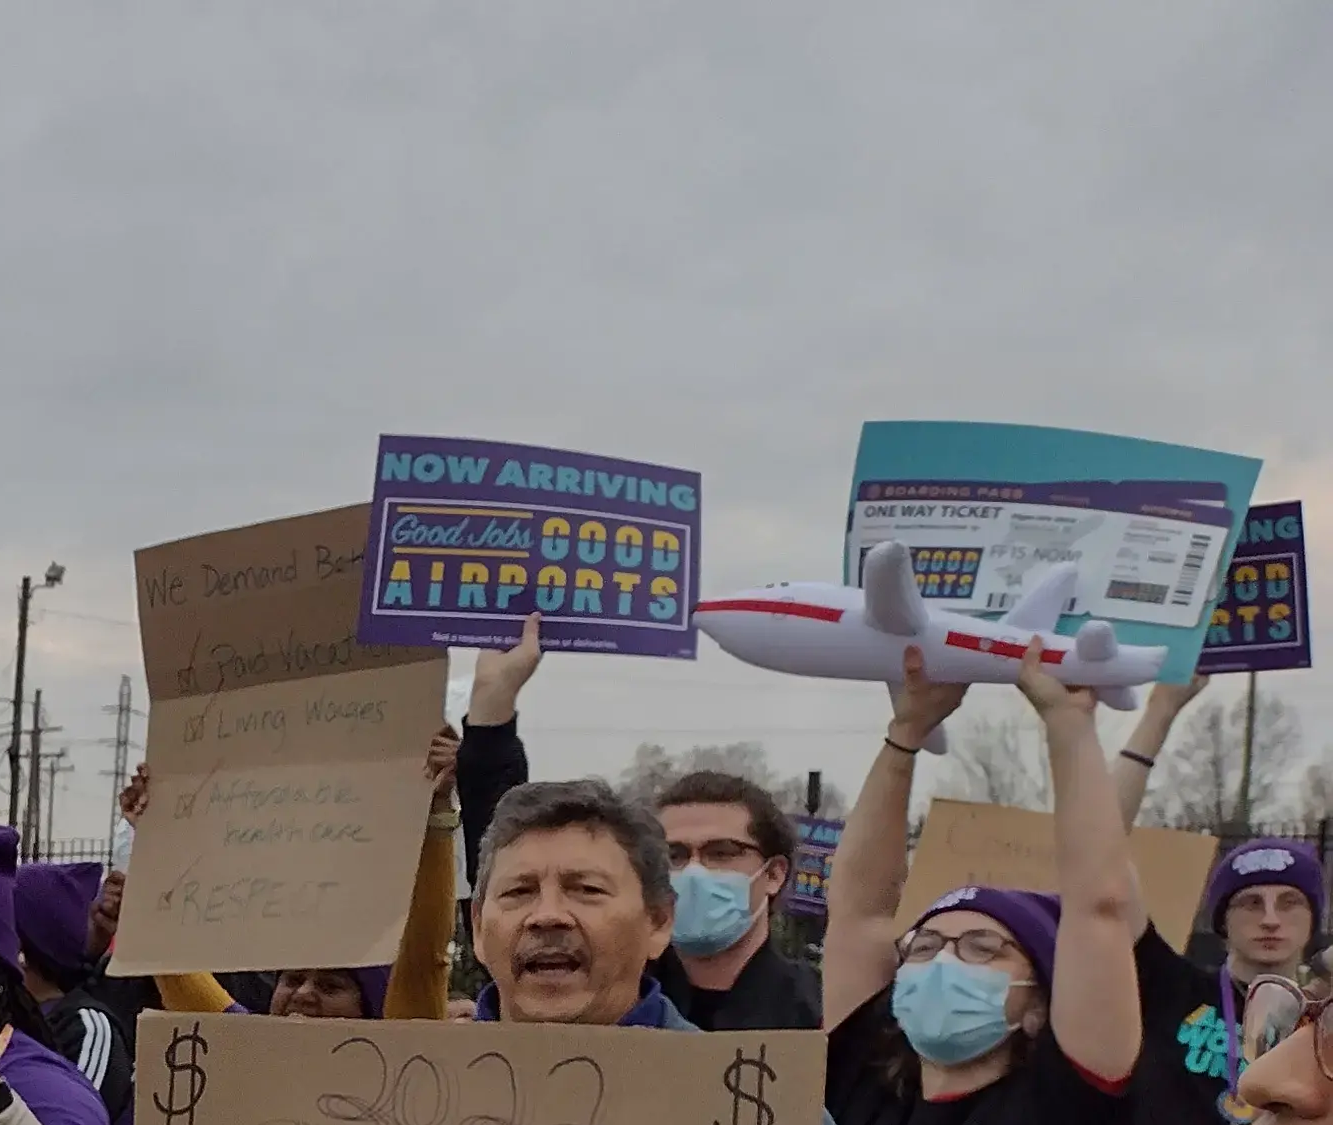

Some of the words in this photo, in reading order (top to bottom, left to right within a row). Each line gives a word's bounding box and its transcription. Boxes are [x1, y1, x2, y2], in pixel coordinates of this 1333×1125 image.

[381, 451, 490, 486] NOW
[495, 458, 698, 512] ARRIVING
[863, 505, 896, 519] ONE
[902, 504, 935, 519] WAY
[941, 506, 1004, 520] TICKET
[390, 513, 468, 546] Good
[467, 516, 534, 551] Jobs
[540, 516, 682, 572] GOOD
[915, 550, 979, 573] GOOD
[144, 566, 188, 609] We
[201, 550, 299, 598] Demand
[383, 558, 679, 621] AIRPORTS
[181, 876, 340, 926] RESPECT
